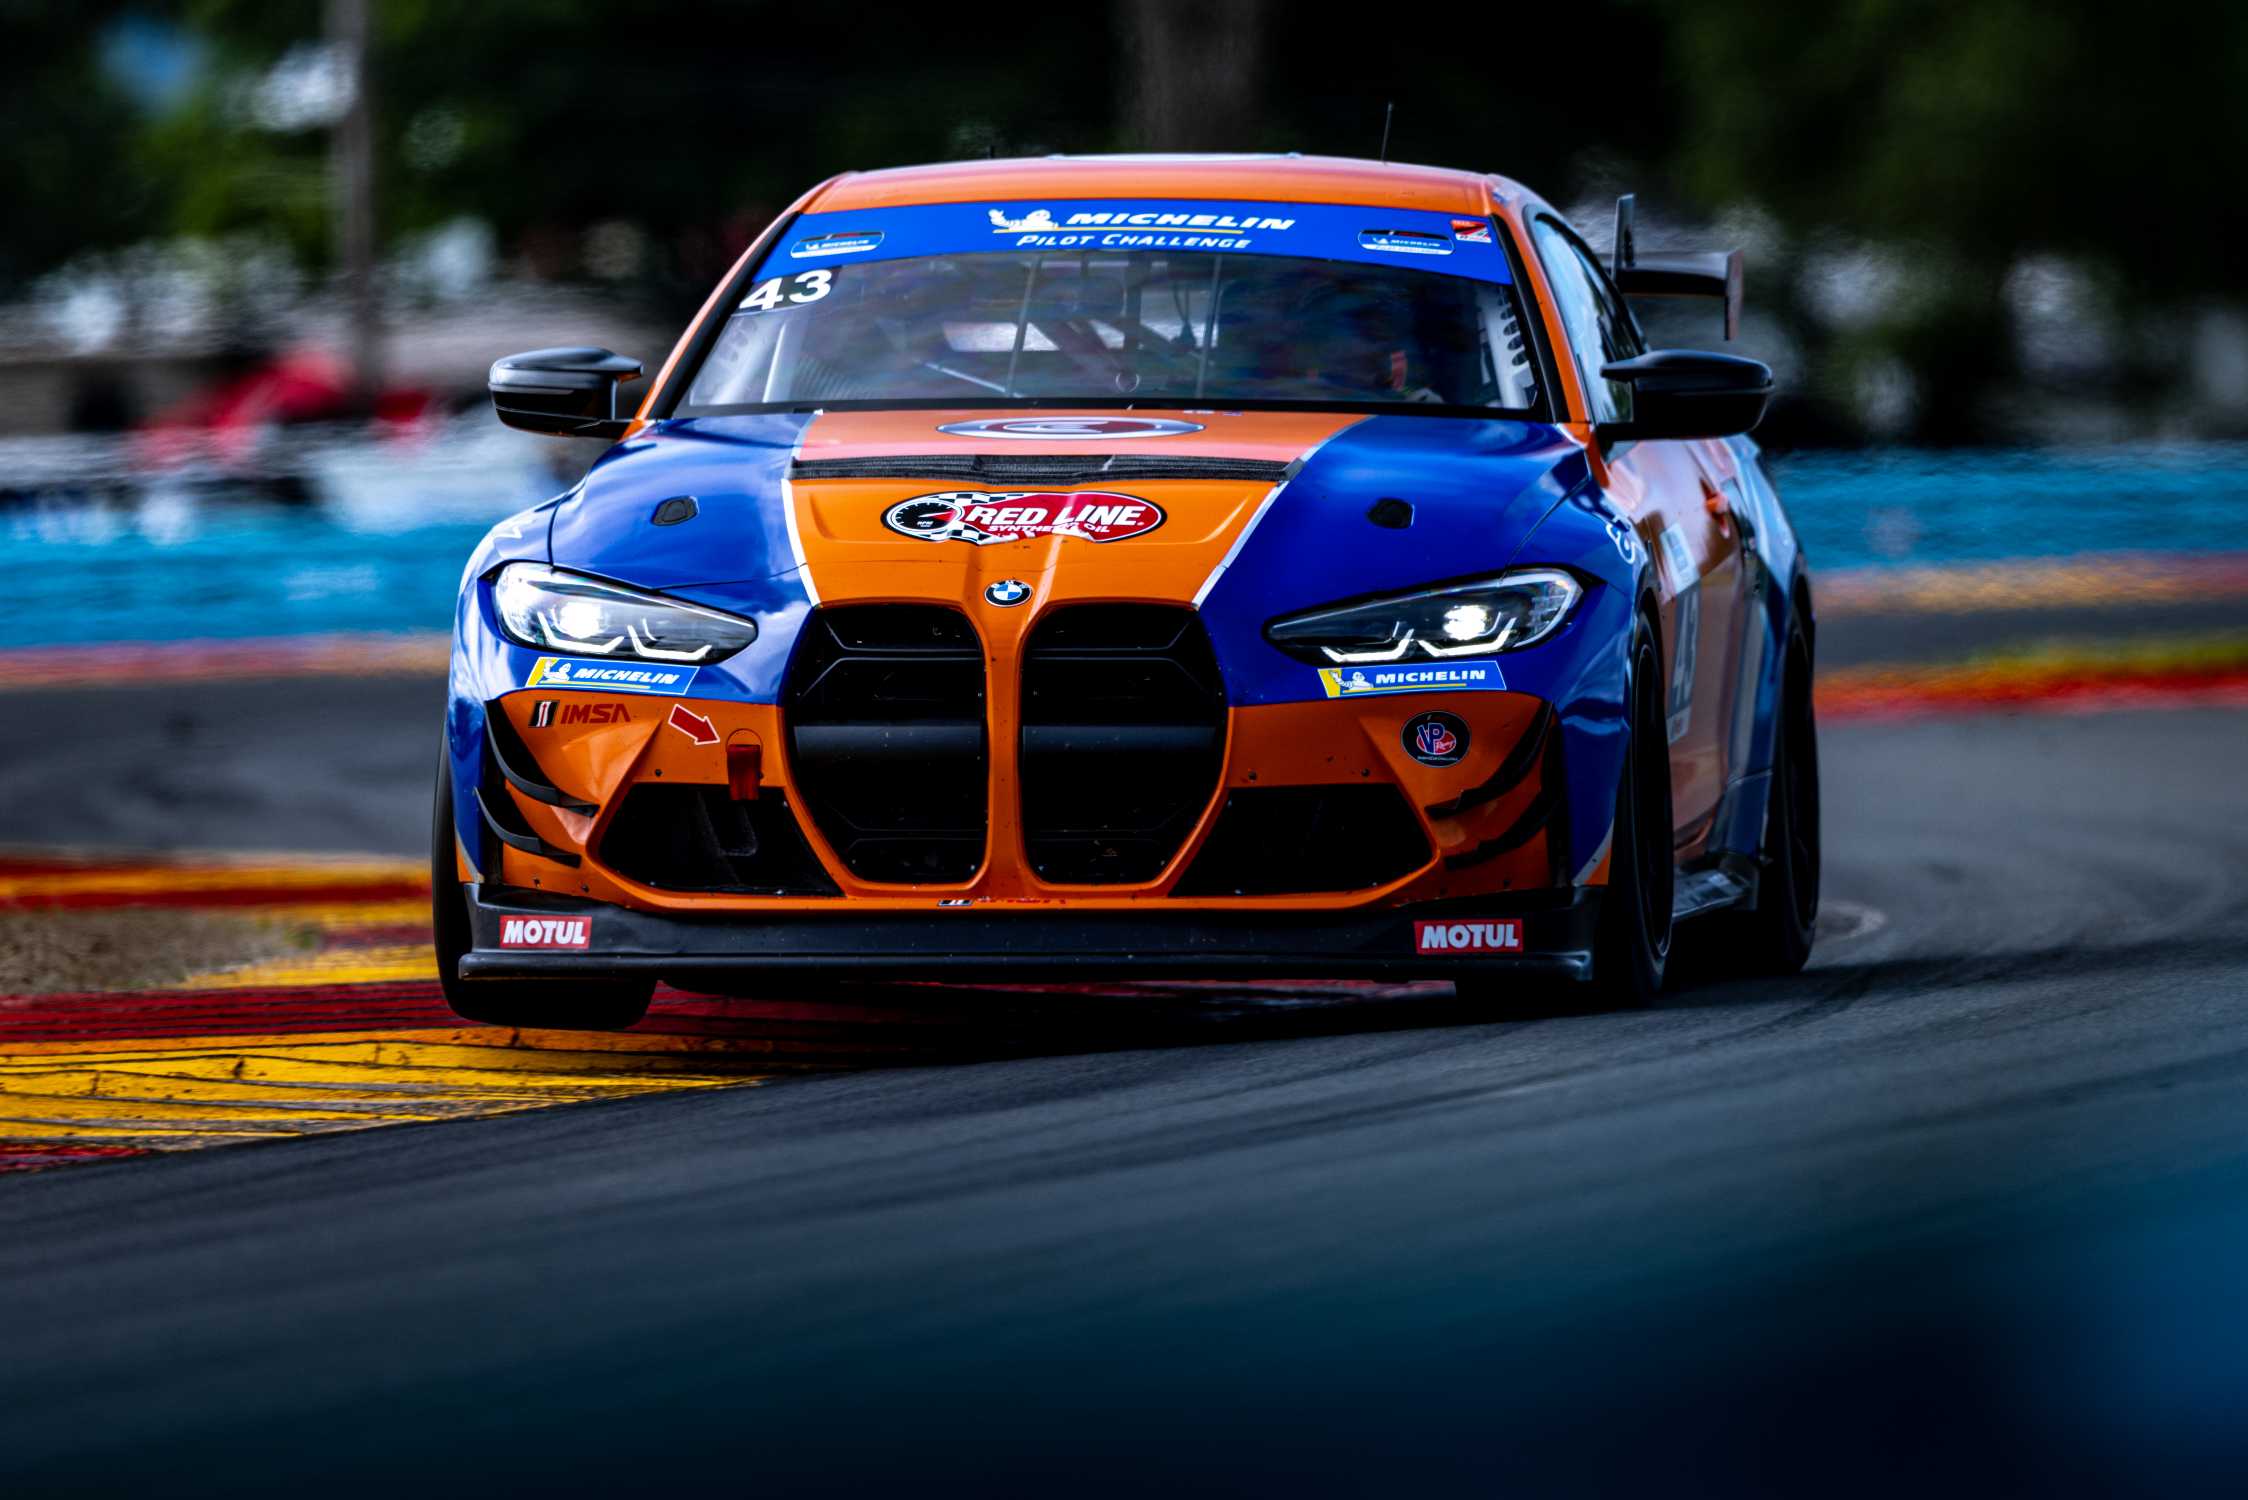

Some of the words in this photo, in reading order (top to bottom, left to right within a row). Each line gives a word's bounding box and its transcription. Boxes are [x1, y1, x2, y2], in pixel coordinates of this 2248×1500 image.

[1066, 213, 1296, 231] MICHELIN
[1016, 234, 1095, 247] PILOT
[1101, 233, 1252, 249] CHALLENGE
[738, 269, 833, 311] 43
[965, 505, 1049, 526] RED
[1052, 504, 1147, 527] LINE
[1083, 522, 1111, 534] OIL
[573, 667, 681, 685] MICHELIN
[1375, 669, 1487, 685] MICHELIN
[560, 703, 632, 725] IMSA
[1416, 722, 1446, 755] VP
[502, 920, 587, 945] MOTUL
[1420, 923, 1520, 949] MOTUL
